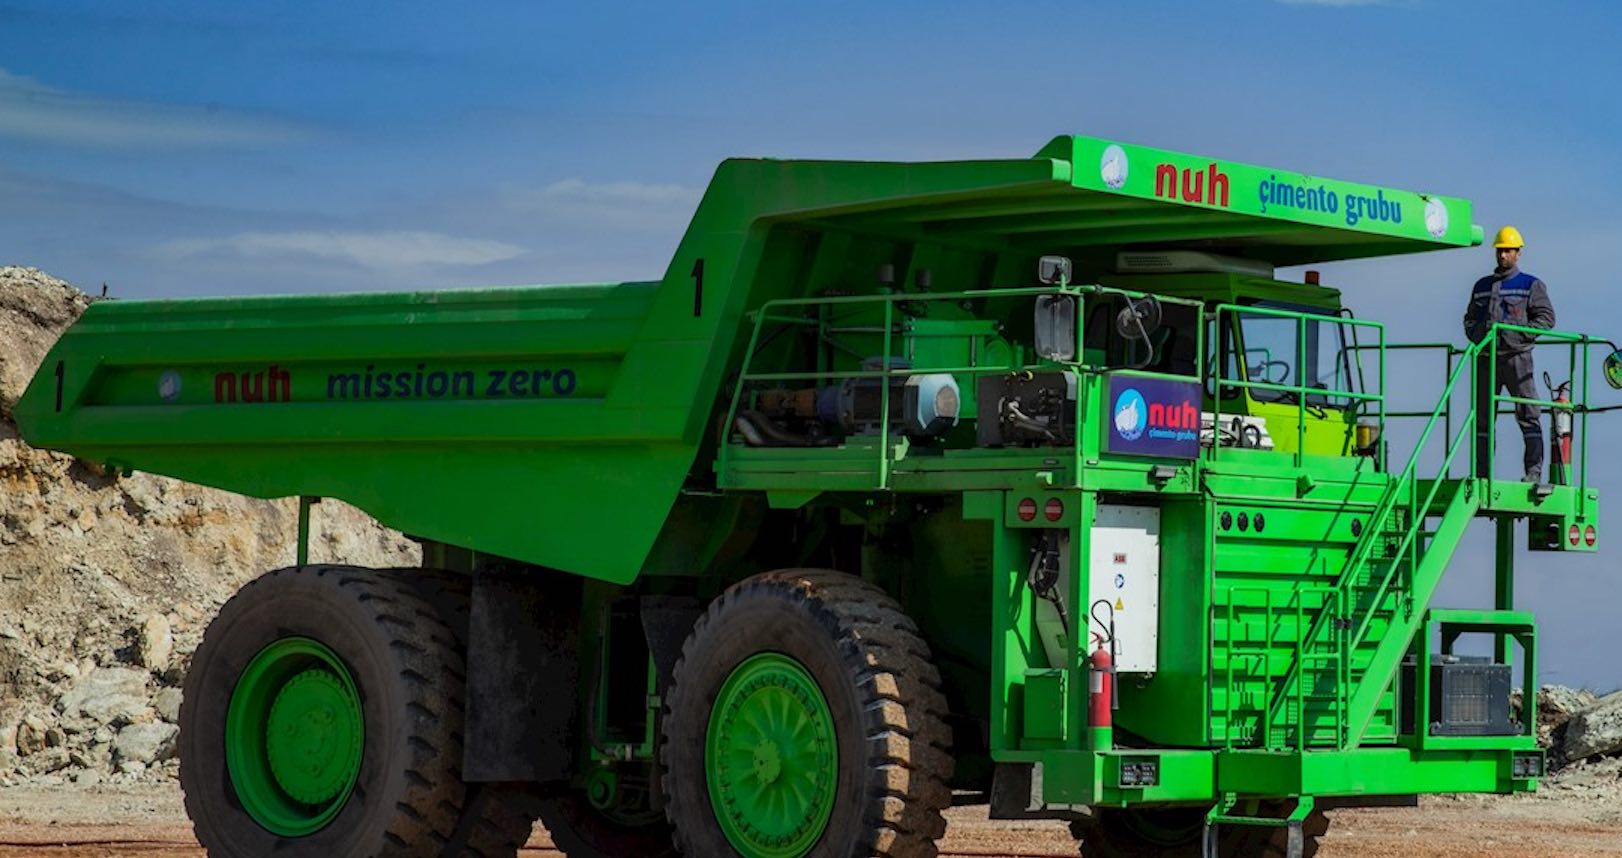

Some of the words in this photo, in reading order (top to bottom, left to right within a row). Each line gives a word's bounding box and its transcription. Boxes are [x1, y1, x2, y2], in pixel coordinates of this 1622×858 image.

[1155, 163, 1229, 207] nuh
[1259, 174, 1338, 213] çimento
[1345, 189, 1402, 225] grubu
[691, 258, 705, 317] 1
[55, 360, 64, 412] 1
[215, 364, 291, 403] nuh
[327, 364, 476, 398] mission
[485, 368, 577, 397] zero
[1149, 401, 1198, 429] nuh
